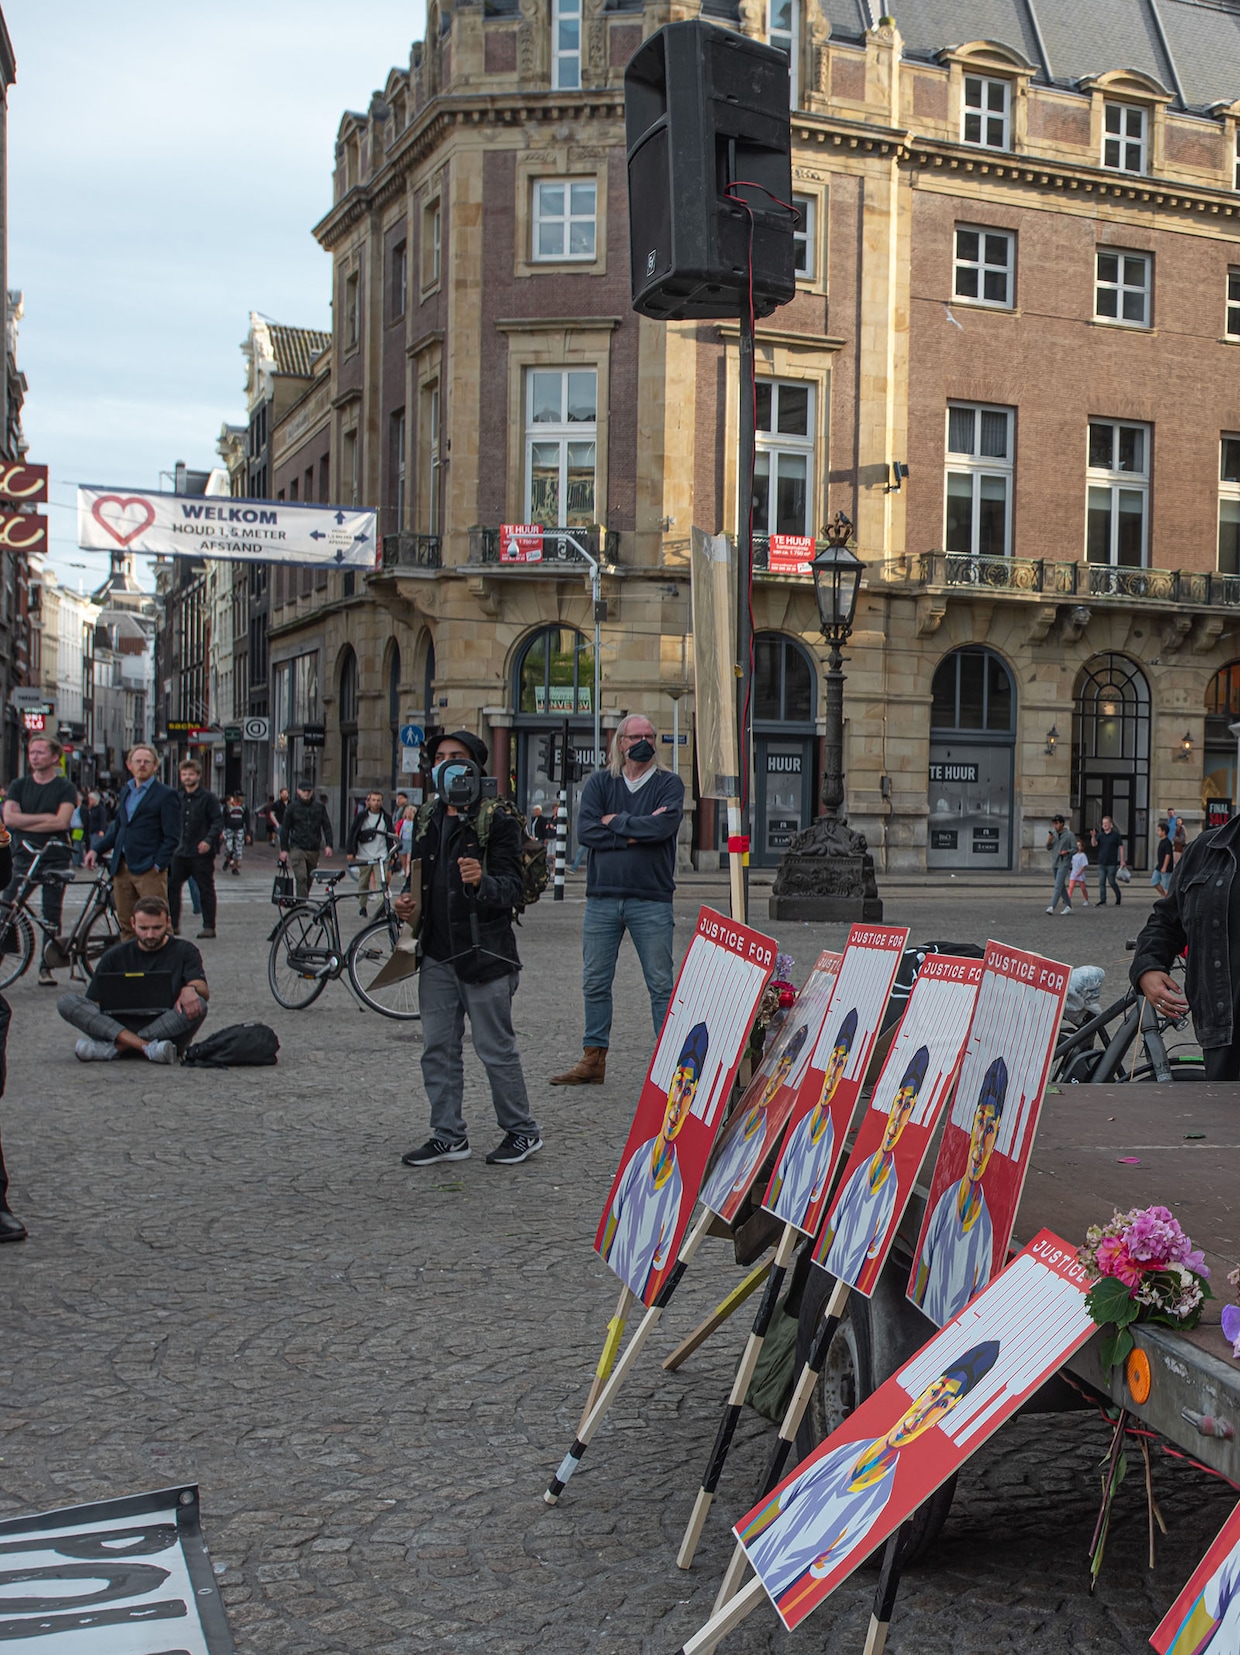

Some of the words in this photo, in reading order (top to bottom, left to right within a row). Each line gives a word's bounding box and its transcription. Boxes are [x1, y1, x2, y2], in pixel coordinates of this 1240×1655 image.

[181, 503, 278, 525] WELKOM
[172, 523, 214, 537] HOUD
[242, 529, 286, 541] METER
[504, 525, 514, 534] TE
[515, 525, 539, 534] HUUR
[200, 541, 263, 554] AFSTAND
[774, 536, 784, 545] TE
[786, 537, 811, 546] HUUR
[768, 756, 801, 772] HUUR
[930, 765, 942, 779] TE
[945, 766, 975, 780] HUUR
[1209, 803, 1228, 813] FINAL
[1209, 813, 1229, 826] SALE
[700, 918, 744, 951] JUSTICE
[749, 943, 772, 966] FOR
[851, 931, 886, 946] JUSTICE
[888, 935, 904, 948] FOR
[817, 957, 841, 971] JUSTI
[923, 963, 964, 980] JUSTICE
[968, 968, 982, 981] FO
[987, 952, 1036, 981] JUSTICE
[1040, 969, 1065, 991] FOR
[1033, 1240, 1087, 1283] JUSTICE
